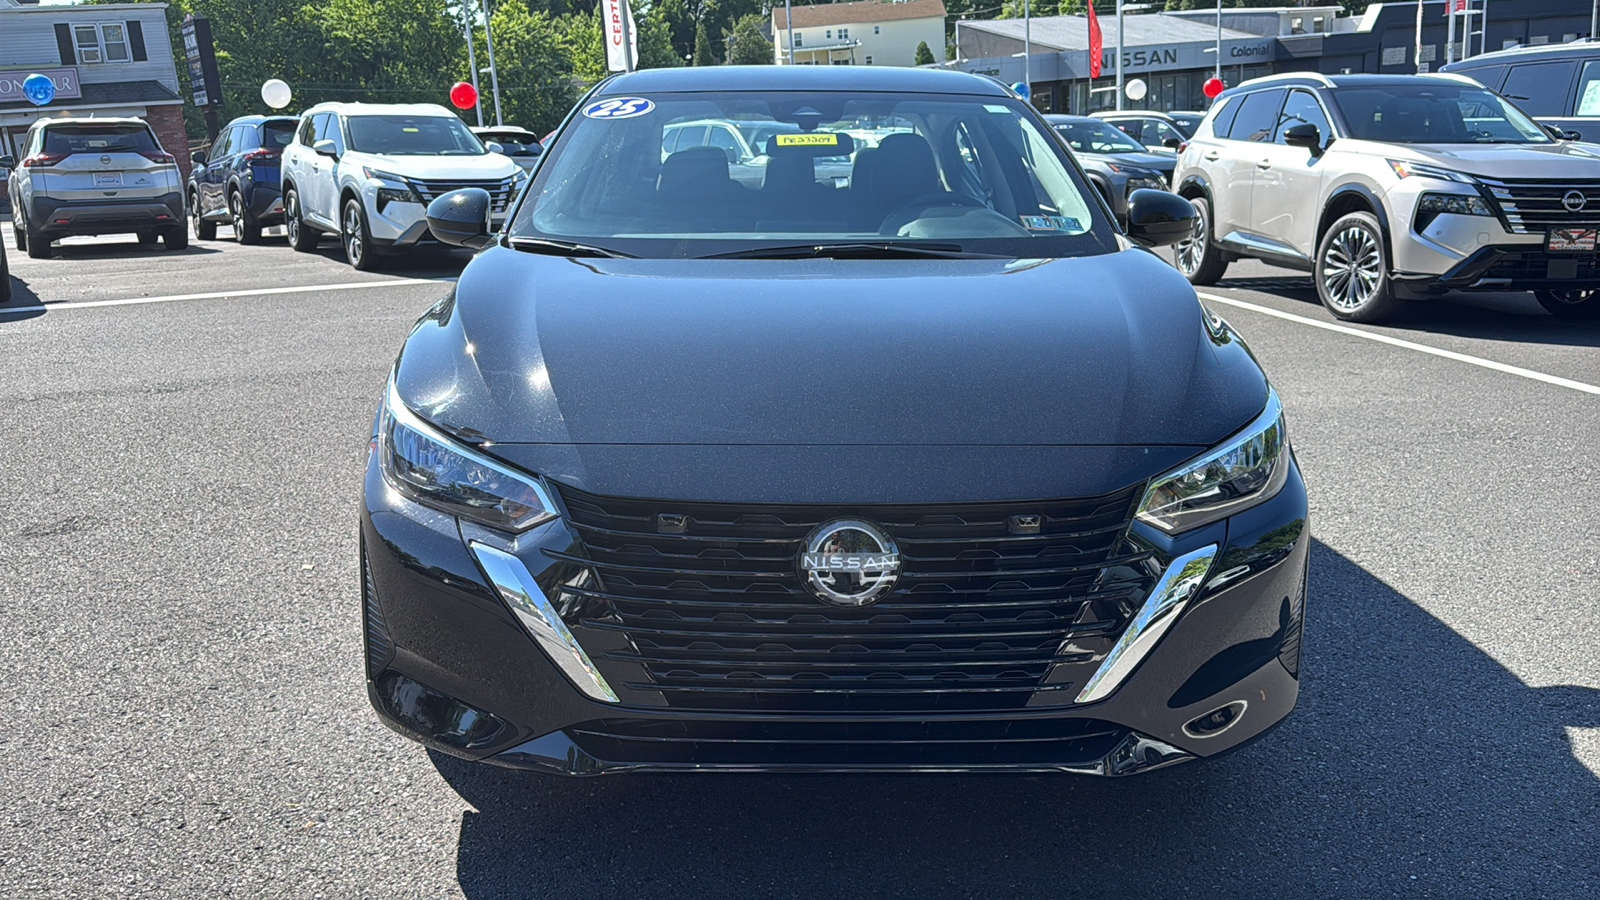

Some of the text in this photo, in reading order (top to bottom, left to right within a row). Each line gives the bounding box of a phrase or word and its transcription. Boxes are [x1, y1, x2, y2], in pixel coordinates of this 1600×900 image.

[1230, 44, 1269, 58] Colonial
[591, 99, 646, 117] 25
[804, 556, 895, 569] NISSAN
